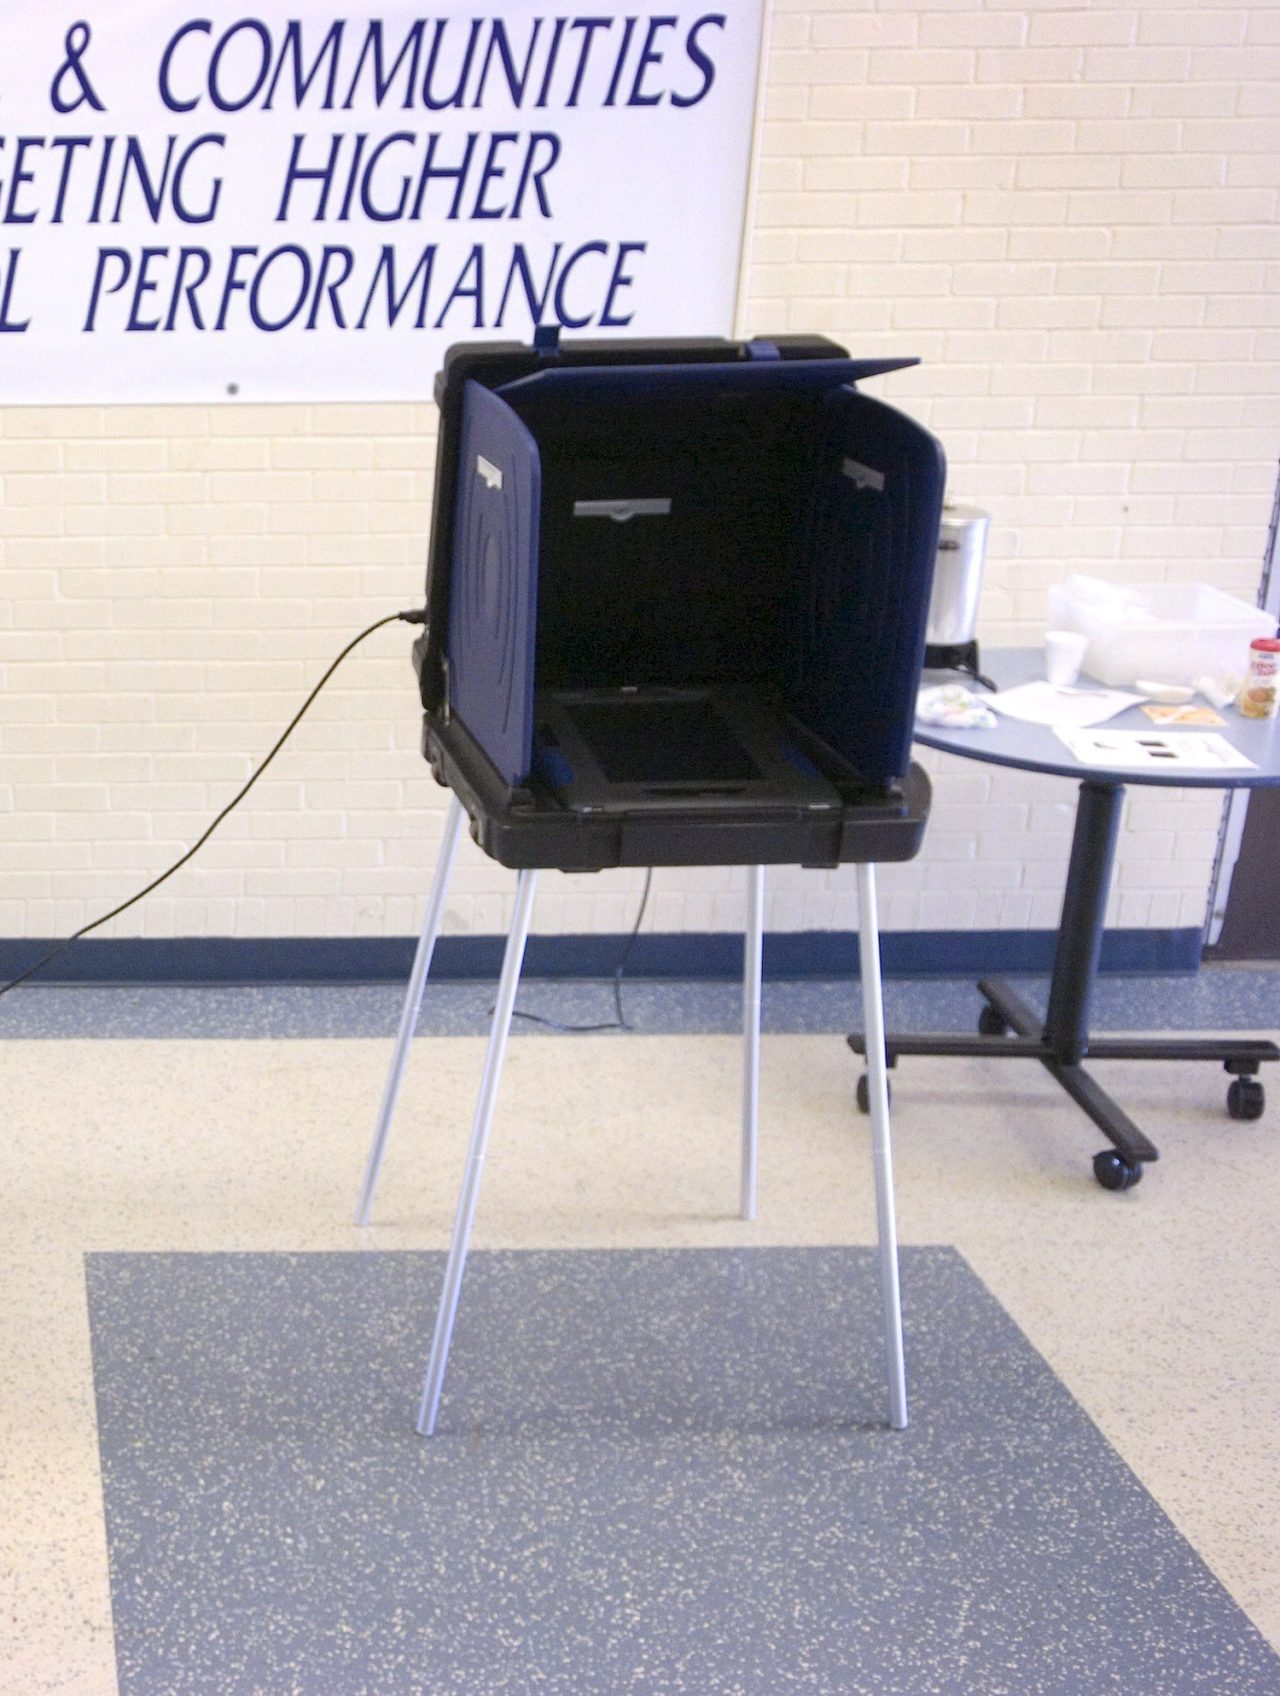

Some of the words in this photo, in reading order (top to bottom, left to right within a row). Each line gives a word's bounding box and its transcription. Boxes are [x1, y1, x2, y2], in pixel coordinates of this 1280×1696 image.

[51, 22, 105, 113] &
[159, 14, 726, 112] COMMUNITIES
[276, 132, 560, 222] HIGHER
[84, 242, 646, 331] PERFORMANCE
